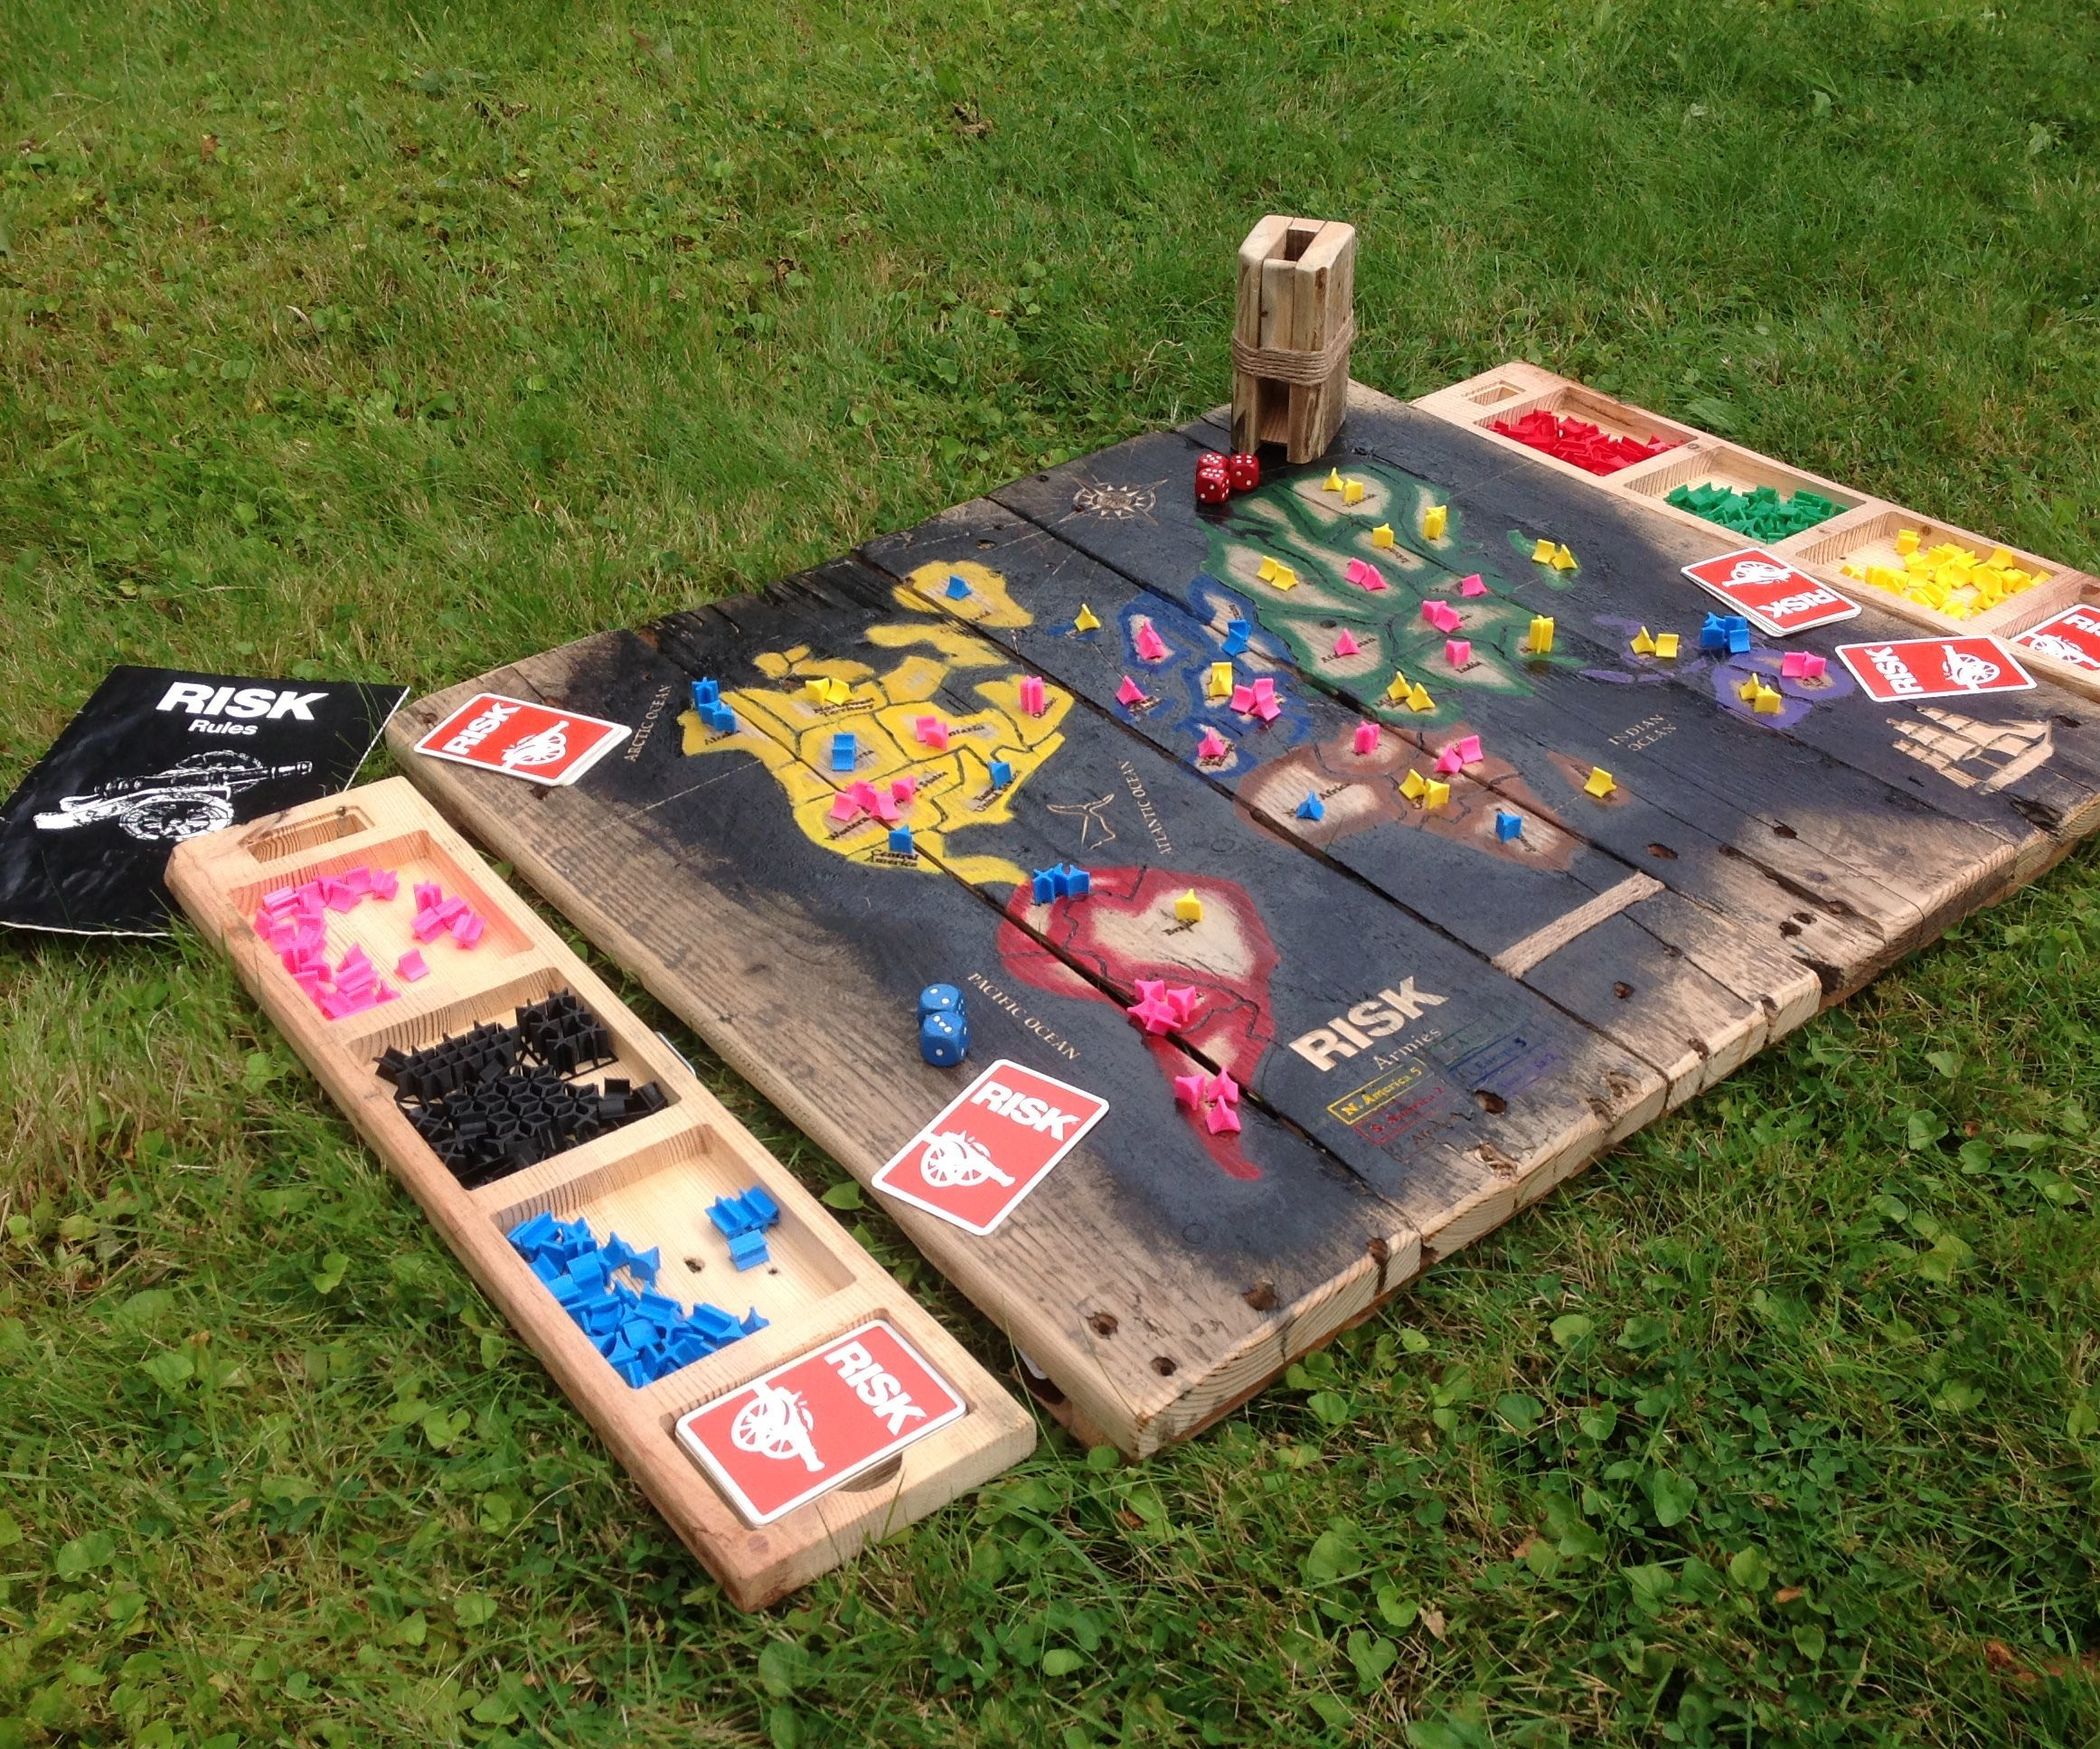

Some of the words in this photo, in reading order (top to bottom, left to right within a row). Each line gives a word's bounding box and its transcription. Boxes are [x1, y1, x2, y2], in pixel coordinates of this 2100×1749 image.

[1755, 588, 1839, 619] RISK
[2062, 613, 2100, 637] RI
[1456, 660, 1482, 674] India
[1863, 646, 1925, 695] RISK
[156, 682, 329, 720] RISK
[188, 719, 258, 736] Rules
[442, 702, 521, 756] RISK
[624, 721, 654, 762] ARCTIC
[645, 684, 673, 720] OCEAN
[1608, 714, 1665, 746] INDIAN
[1628, 723, 1677, 752] OCEAN
[1119, 760, 1146, 797] OCEAN
[1138, 800, 1173, 855] ATLANTIC
[967, 972, 1027, 1018] PACIFIC
[1024, 1016, 1081, 1060] OCEAN
[1289, 976, 1449, 1072] RISK
[1373, 1026, 1442, 1071] Armies
[970, 1080, 1081, 1142] RISK
[1361, 1075, 1414, 1106] America
[823, 1340, 928, 1437] RISK
